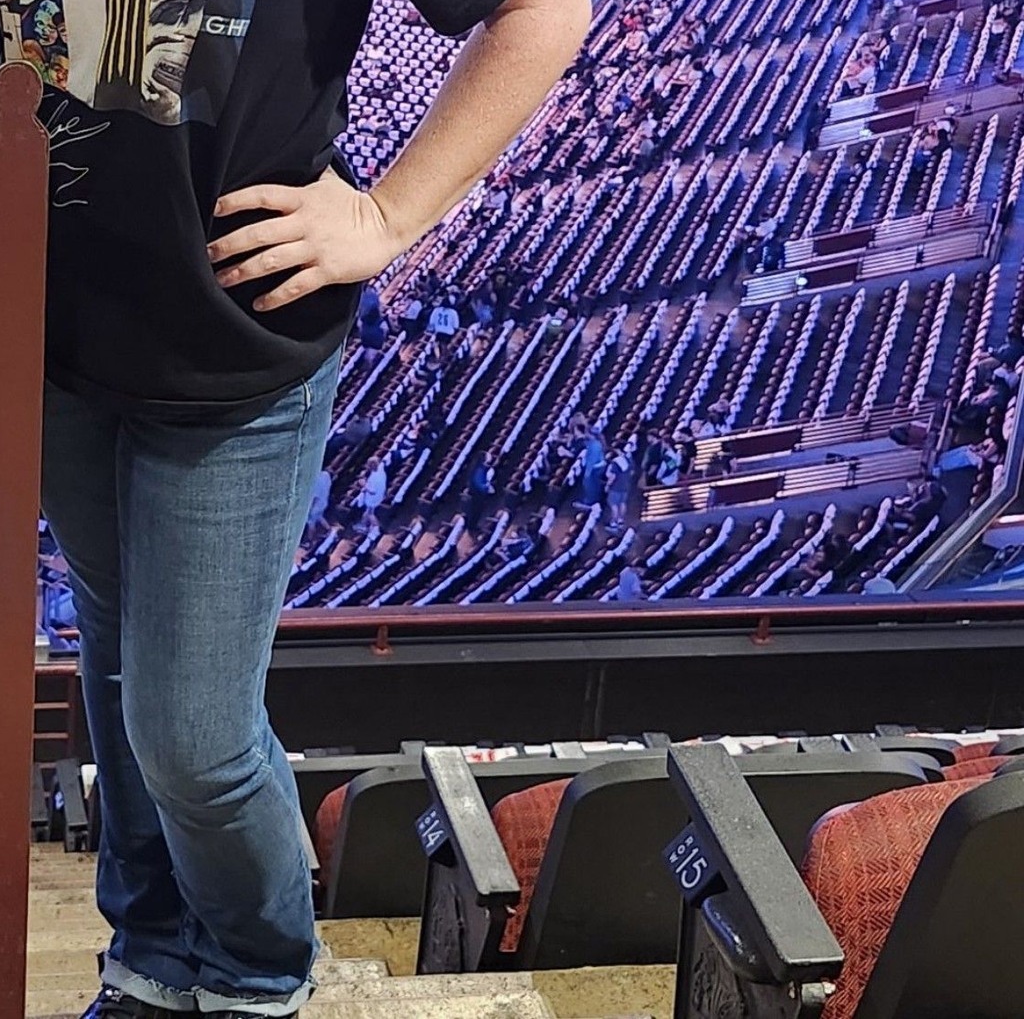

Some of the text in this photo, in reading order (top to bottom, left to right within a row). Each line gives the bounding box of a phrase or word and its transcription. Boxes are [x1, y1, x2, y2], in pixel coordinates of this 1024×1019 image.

[421, 819, 445, 849] 14
[668, 835, 708, 889] ROW 15
